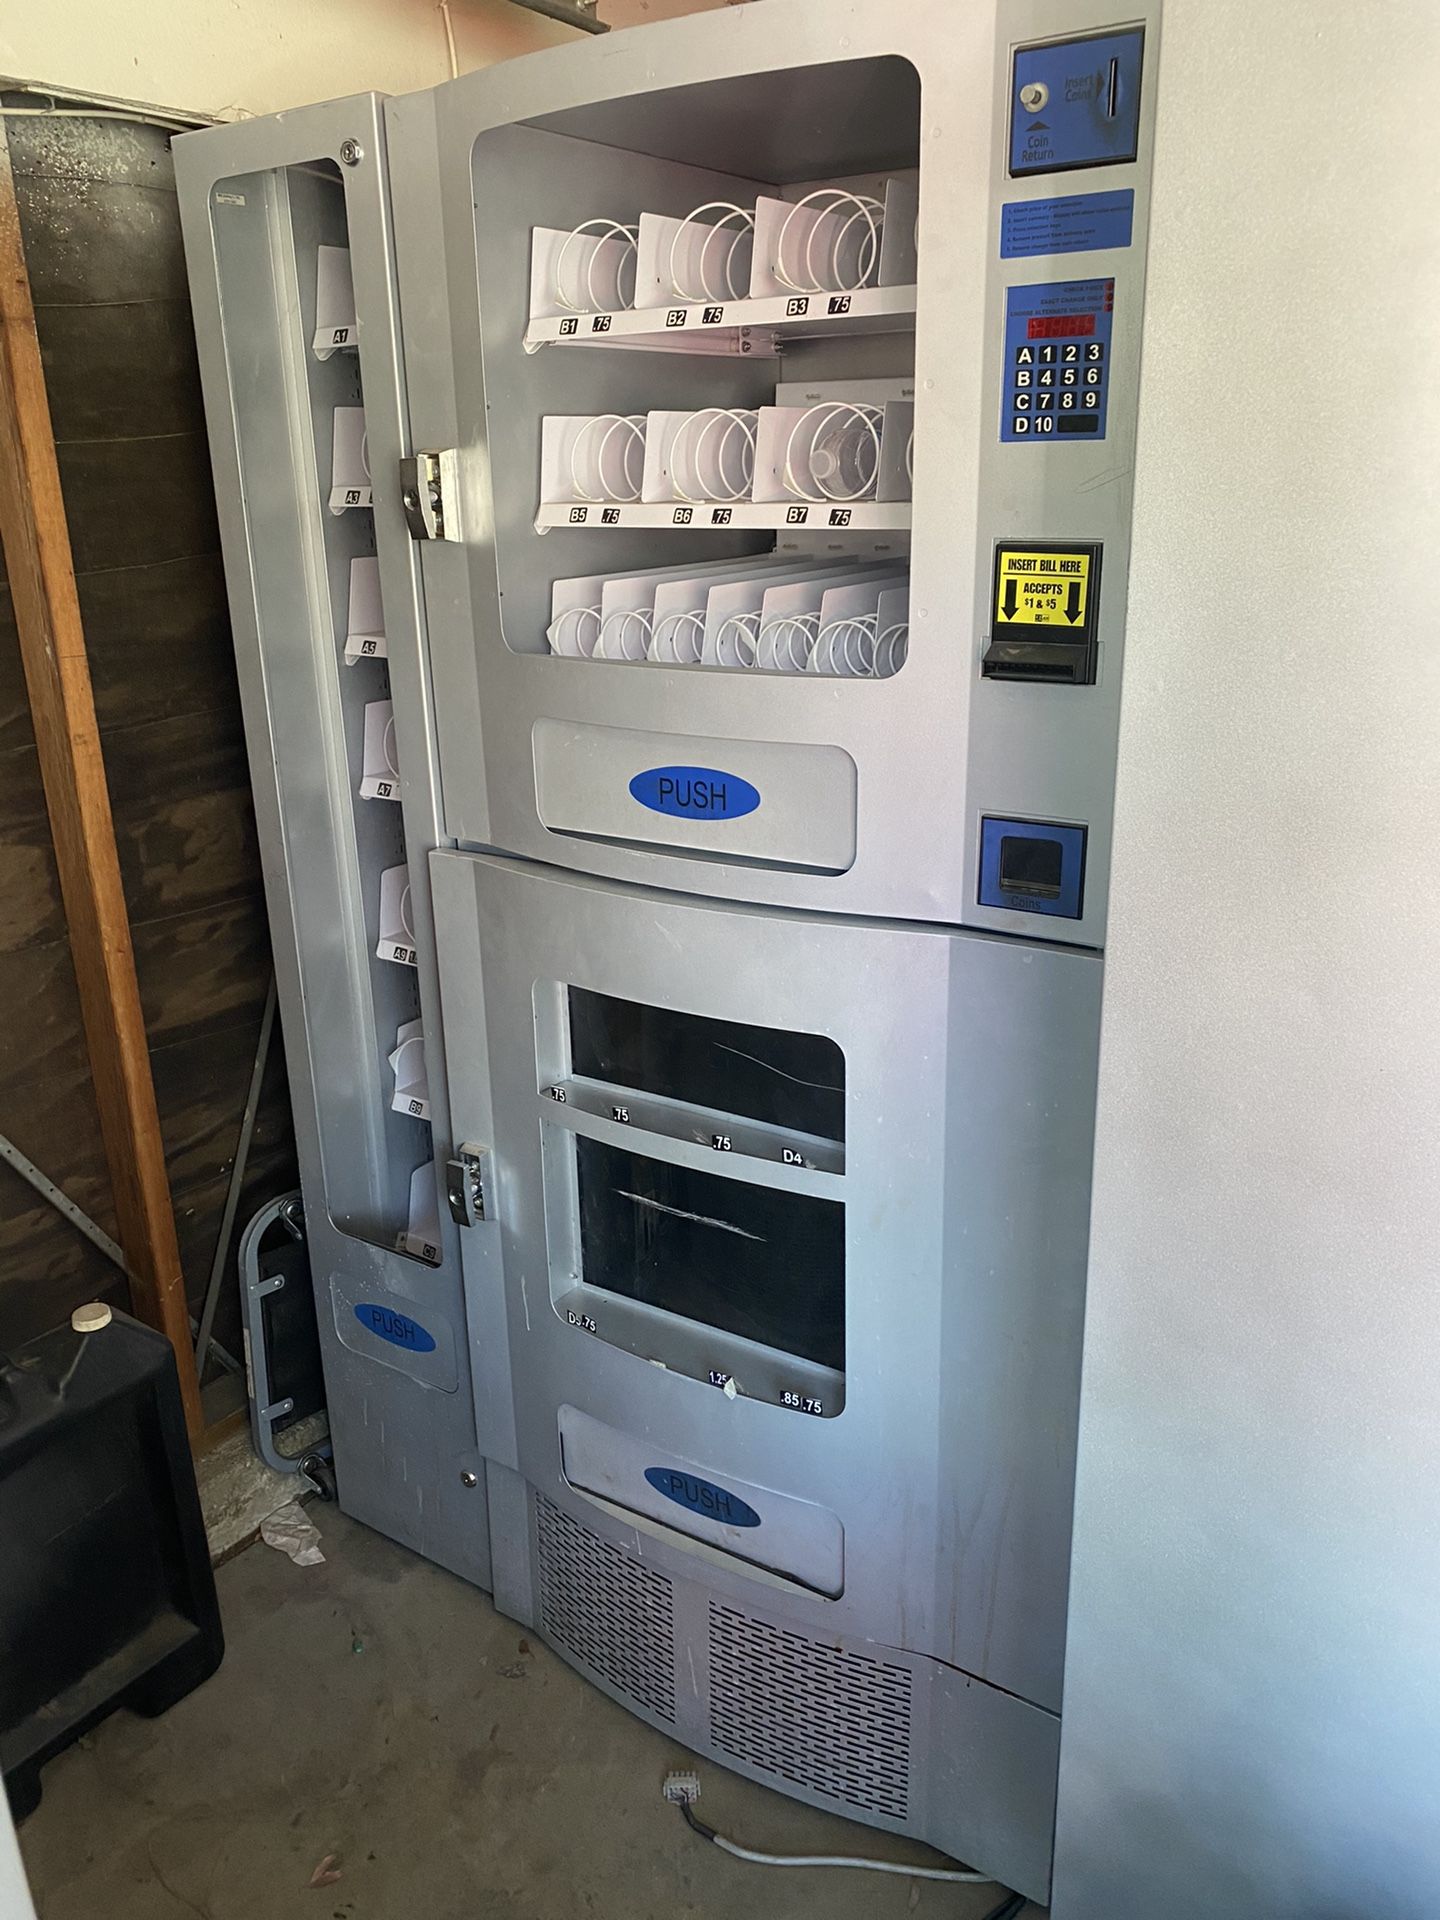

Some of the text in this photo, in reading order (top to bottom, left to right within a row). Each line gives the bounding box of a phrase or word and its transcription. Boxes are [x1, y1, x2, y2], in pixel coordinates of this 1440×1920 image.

[1028, 135, 1048, 149] Coin
[1022, 149, 1054, 163] Return
[788, 298, 850, 314] B3 .75
[668, 309, 721, 324] B2 .75
[561, 318, 610, 332] B1 .75
[334, 331, 347, 342] A1
[1018, 344, 1099, 363] A 1 2 3
[1018, 368, 1098, 386] B 4 5 6
[1016, 392, 1096, 409] C 7 8 9
[1016, 417, 1052, 432] D 10
[347, 492, 358, 503] A3
[571, 508, 619, 523] B5 .75
[675, 509, 731, 523] B6 .75
[789, 508, 850, 525] B7 .75
[1008, 559, 1081, 573] INSERT BILL HERE
[1023, 582, 1063, 595] ACCEPTS
[1024, 598, 1057, 609] $1 & $5
[362, 642, 375, 653] A5
[378, 783, 391, 796] A7
[659, 777, 726, 811] PUSH
[1011, 895, 1041, 908] Coins
[395, 948, 406, 960] A9
[552, 1089, 566, 1101] .75
[411, 1100, 421, 1114] B9
[614, 1108, 629, 1121] .75
[713, 1136, 731, 1150] .75
[783, 1149, 802, 1164] D4
[372, 1311, 415, 1342] PUSH
[582, 1316, 595, 1331] .75
[781, 1392, 822, 1414] .85 .75
[671, 1475, 732, 1516] PUSH
